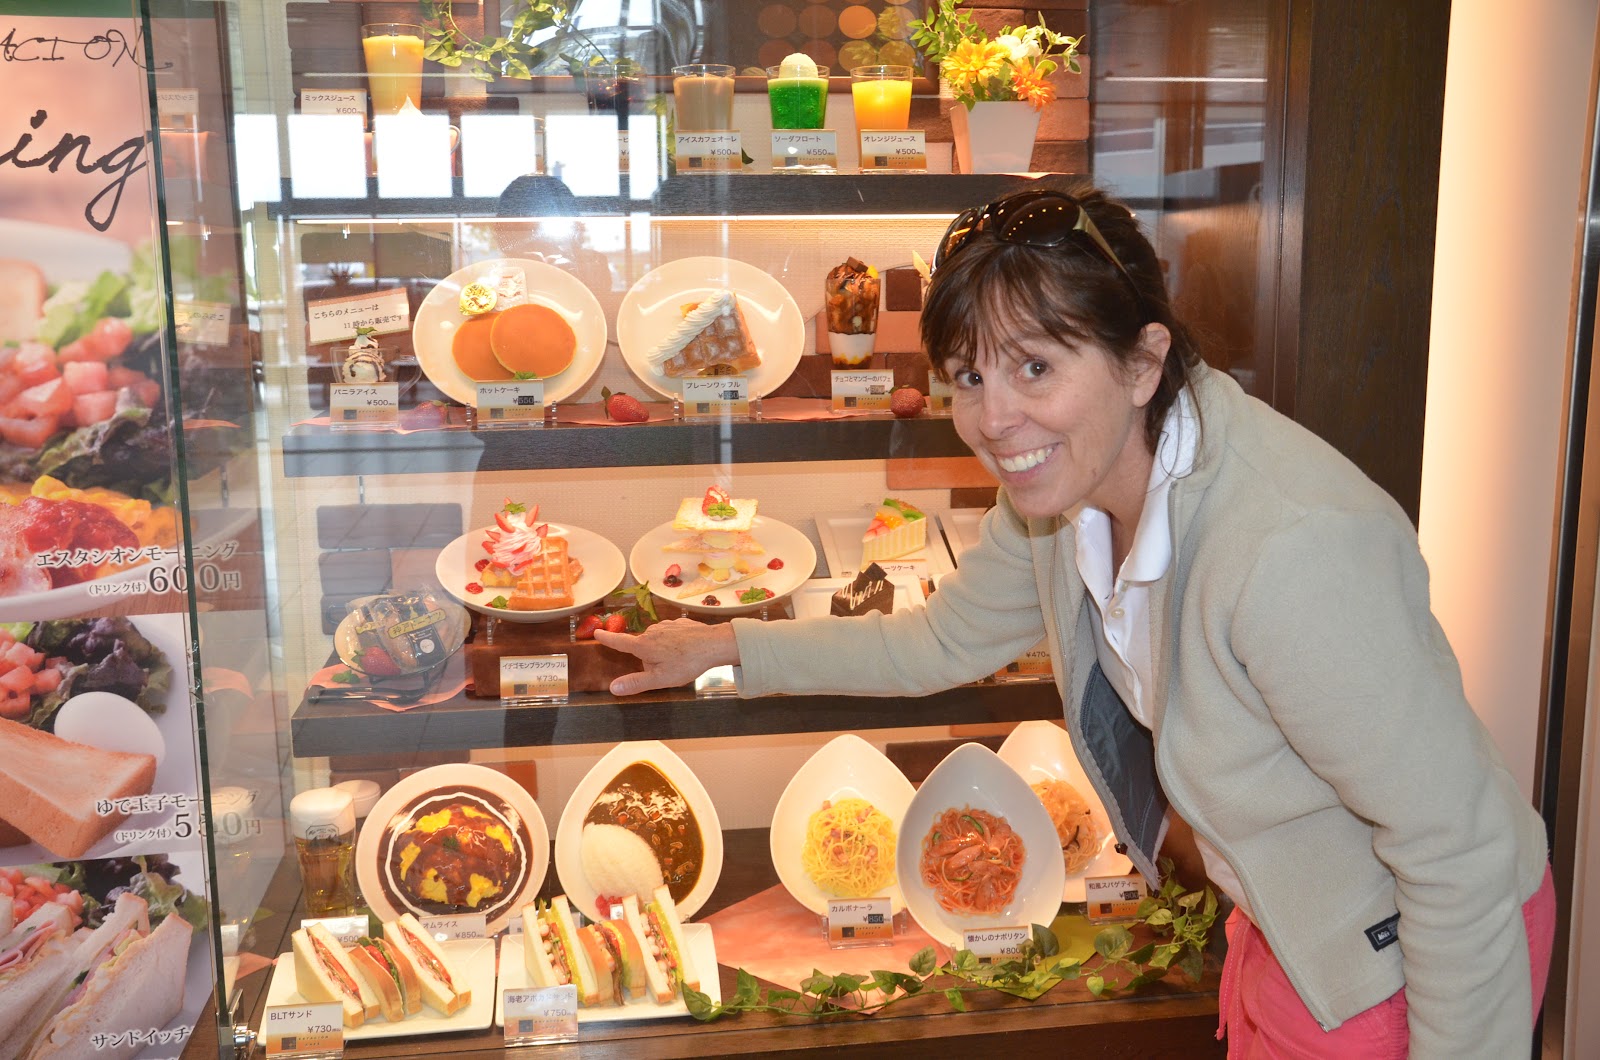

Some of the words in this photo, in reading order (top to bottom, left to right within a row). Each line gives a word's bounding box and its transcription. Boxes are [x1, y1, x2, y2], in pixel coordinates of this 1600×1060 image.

[678, 135, 737, 143] アイスカフェオーレ
[313, 303, 380, 319] こちらのメニューは
[480, 386, 520, 394] ホットケーキ
[503, 661, 566, 670] イチゴモンブランワッフル
[831, 904, 873, 912] カルボナーラ
[423, 921, 458, 929] オムライス
[455, 931, 476, 939] ¥850
[307, 1024, 332, 1033] ¥730
